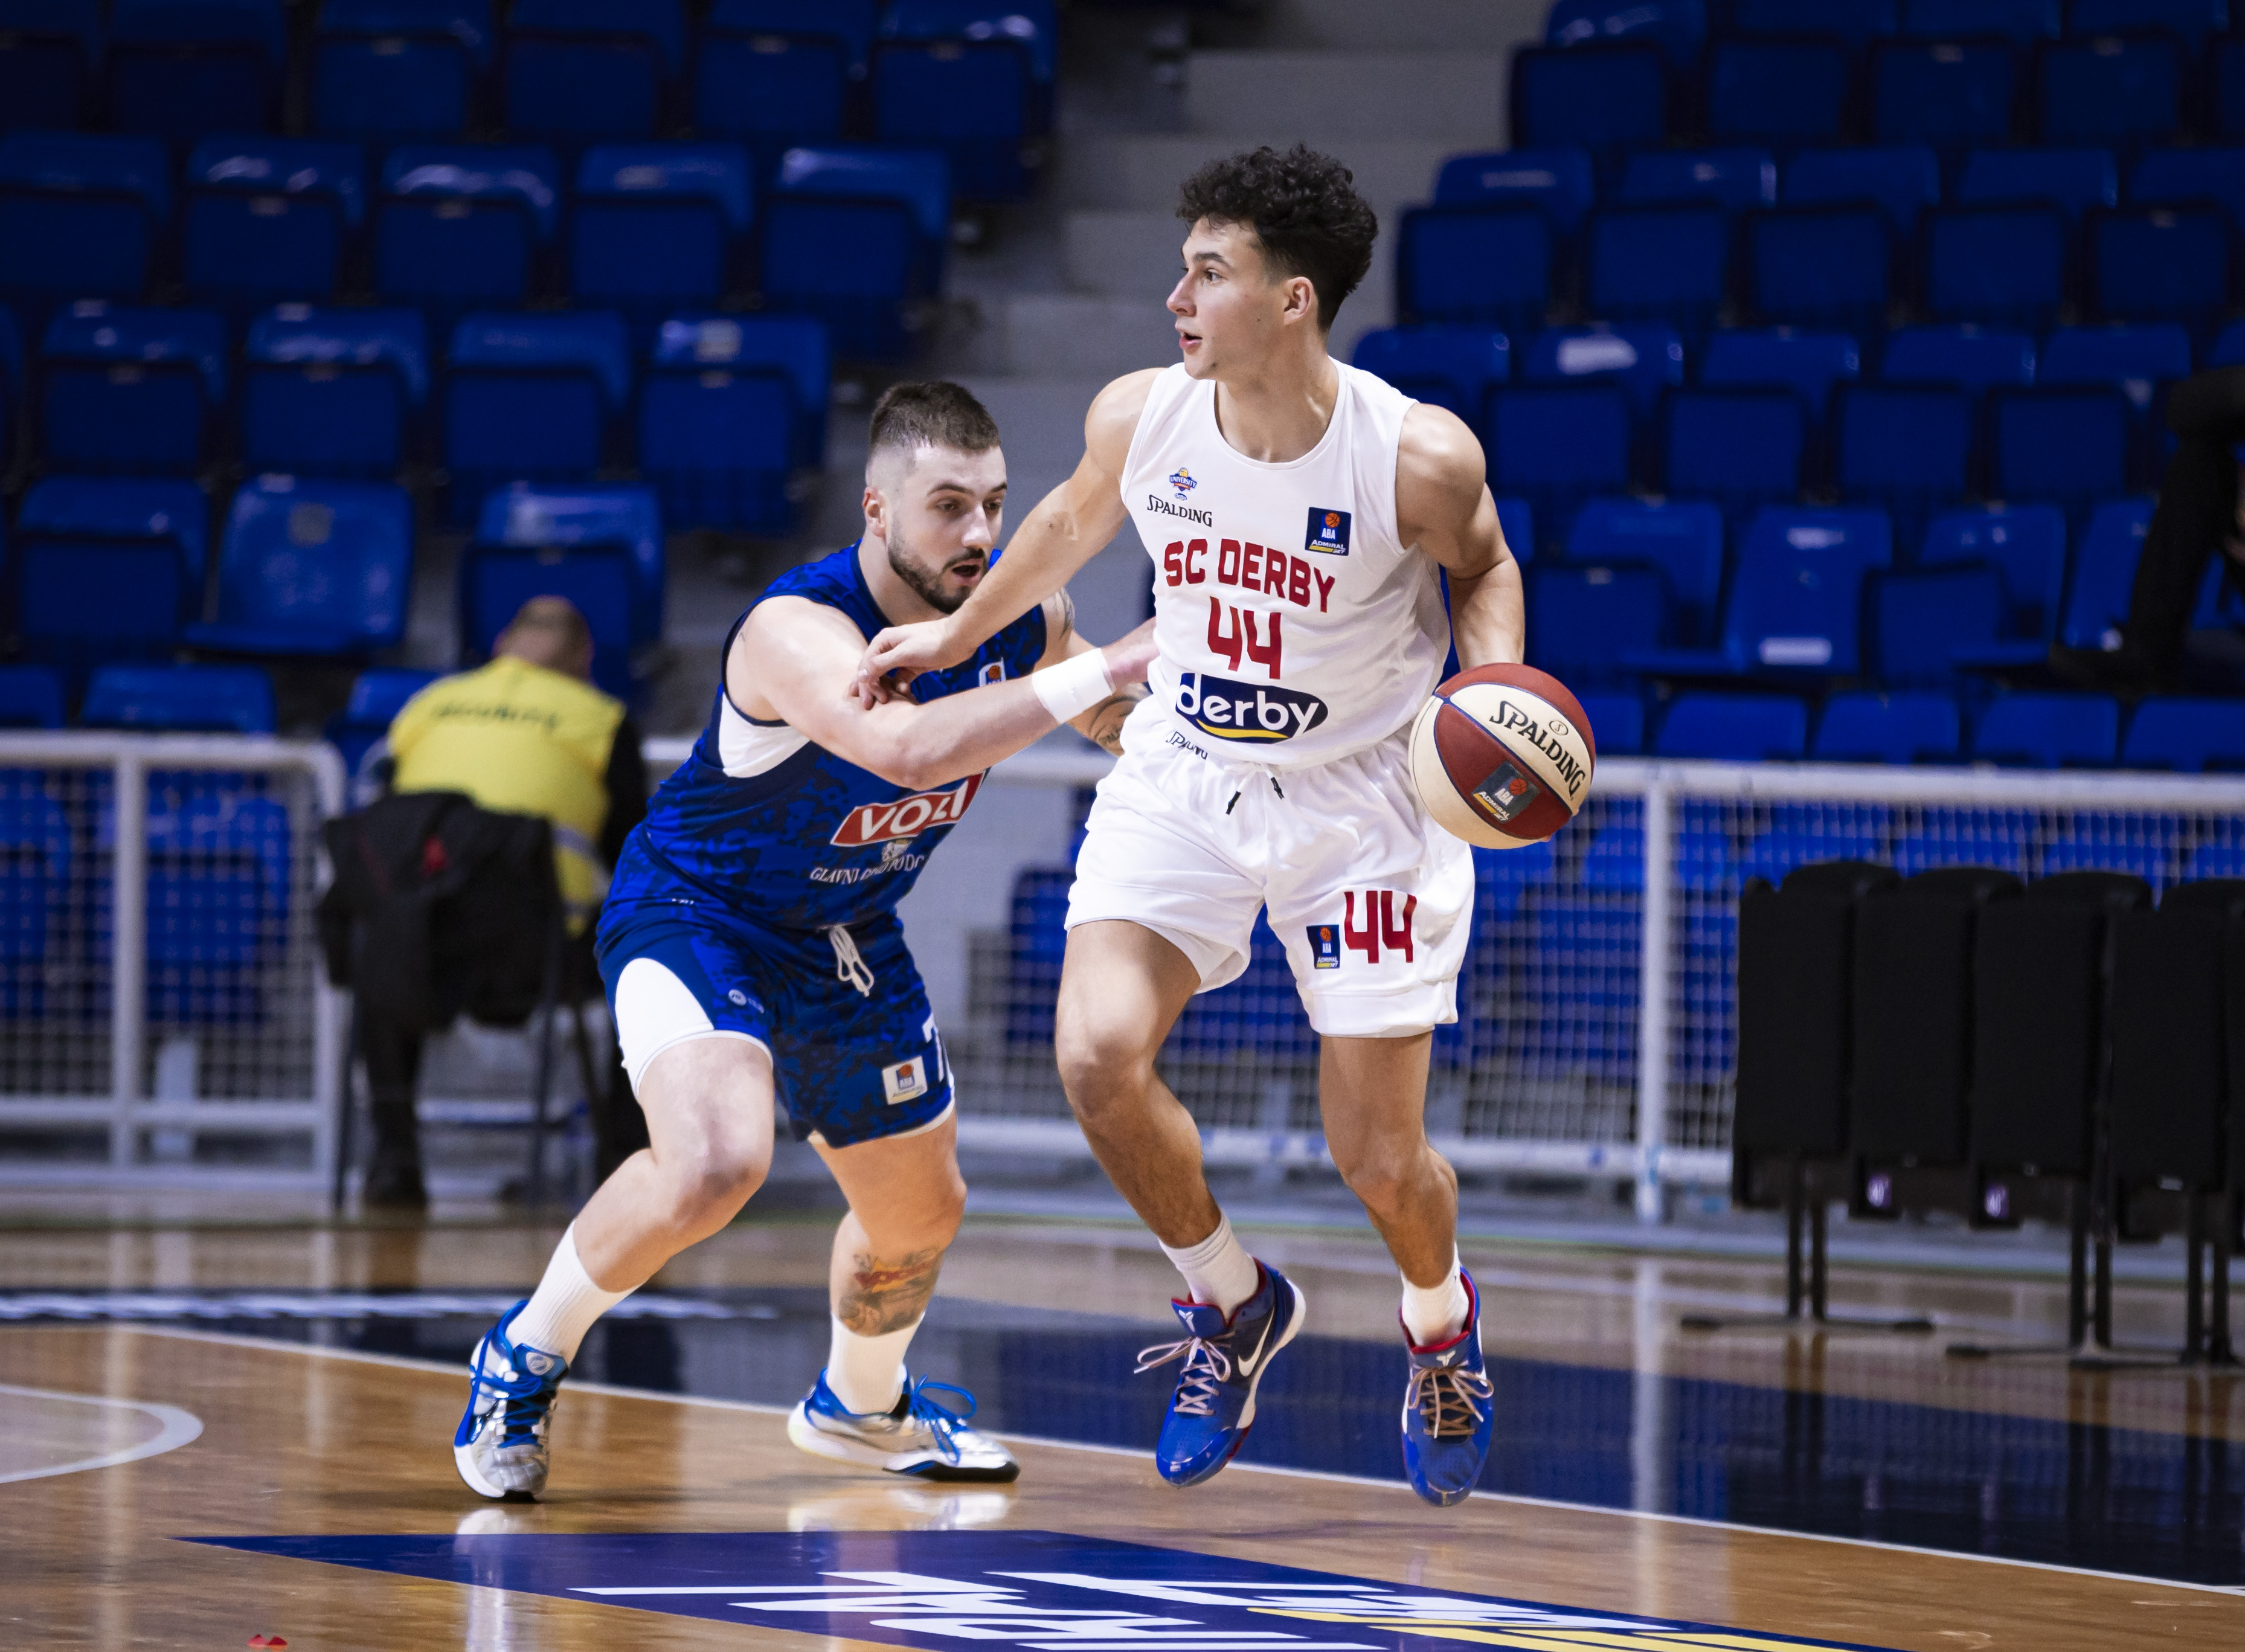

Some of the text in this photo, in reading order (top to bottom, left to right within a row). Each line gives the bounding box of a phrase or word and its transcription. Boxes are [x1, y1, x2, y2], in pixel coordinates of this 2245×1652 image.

[1169, 475, 1196, 488] UNIVERSITY
[1147, 494, 1212, 527] SPALDING
[1310, 539, 1346, 550] ADMIRAL
[1321, 527, 1335, 539] ABA
[1164, 538, 1335, 613] SC DERBY
[1207, 596, 1282, 680] 44
[1177, 673, 1319, 738] derby
[1489, 700, 1586, 798] SPALDING
[1479, 791, 1510, 820] ADMIRAL
[809, 866, 860, 884] GLAVNI
[1344, 890, 1418, 963] 44
